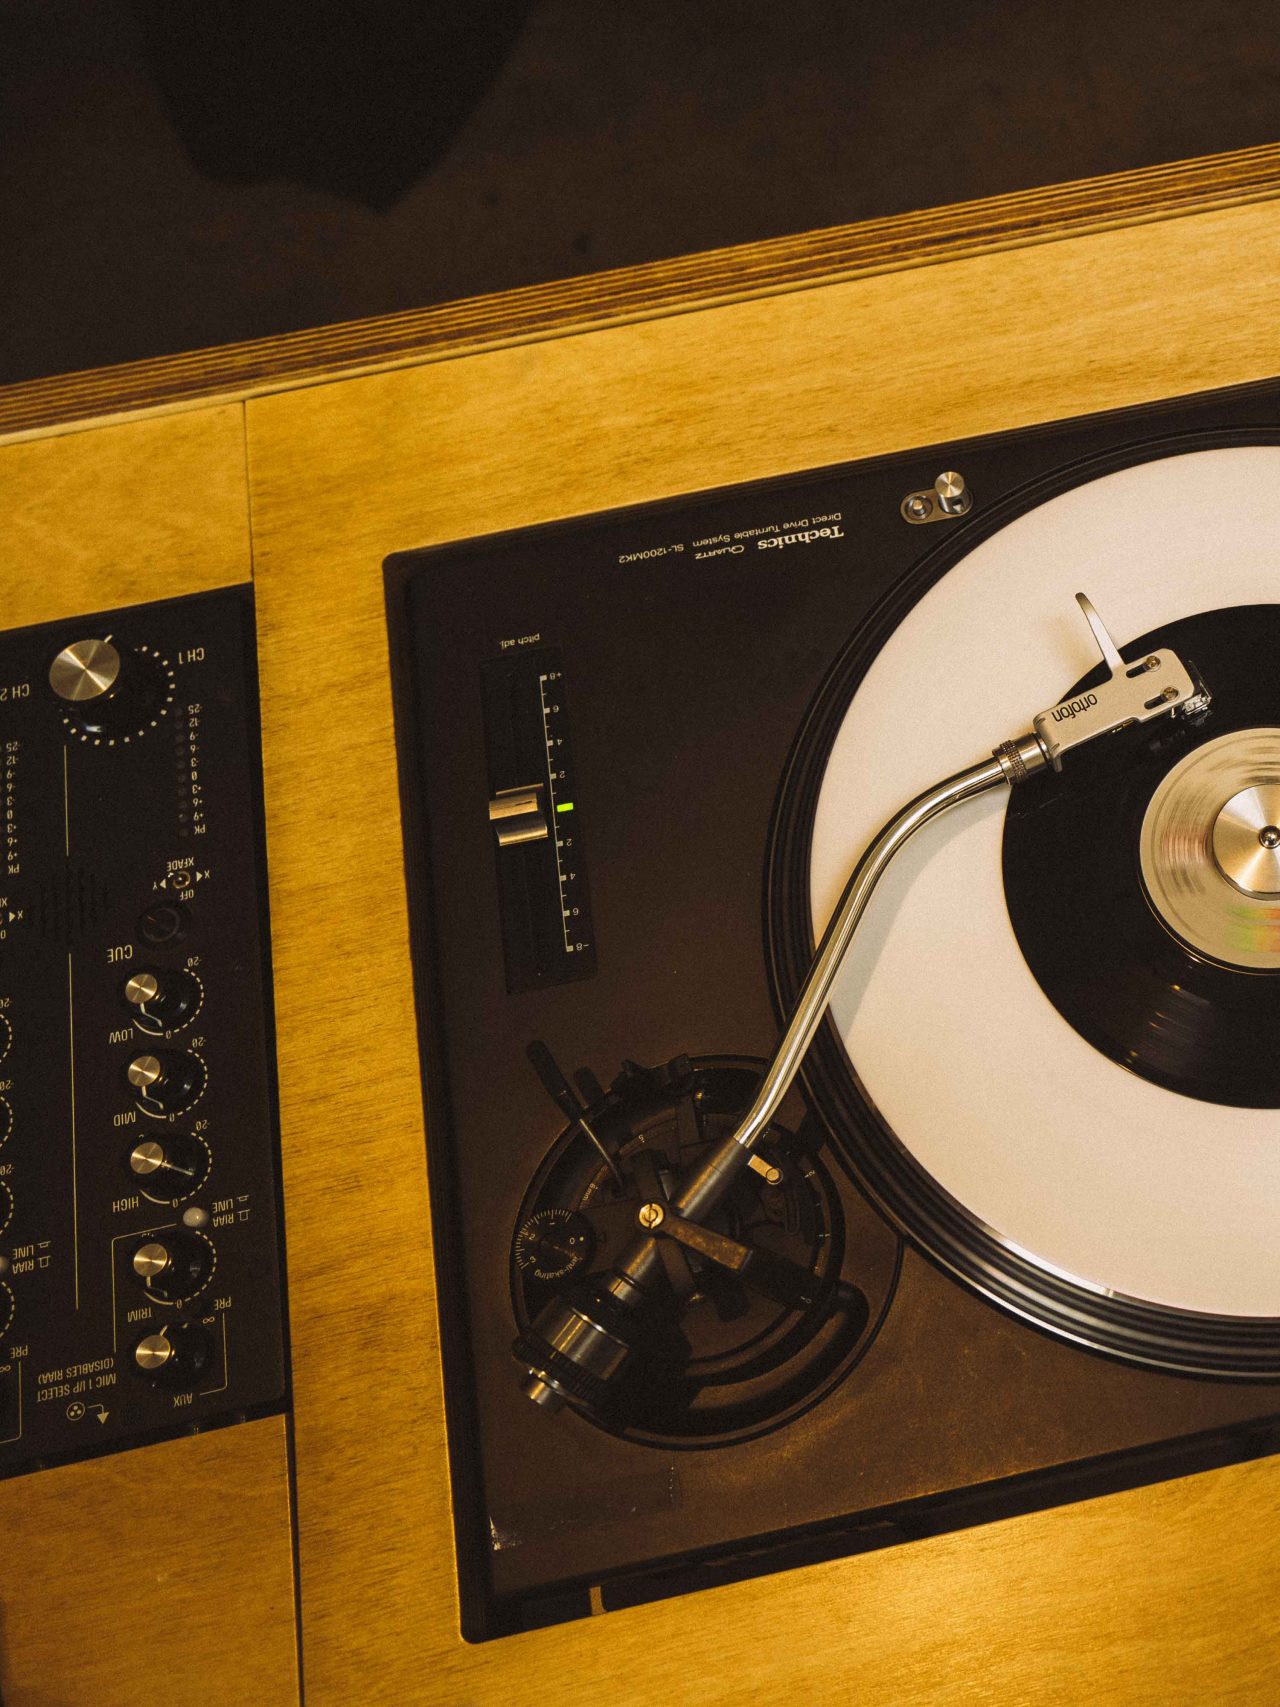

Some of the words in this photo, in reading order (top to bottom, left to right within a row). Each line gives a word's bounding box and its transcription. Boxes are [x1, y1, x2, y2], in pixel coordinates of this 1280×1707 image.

[783, 519, 808, 529] Drive
[812, 513, 841, 524] Direct
[734, 524, 780, 539] Turntable
[757, 525, 844, 550] Technics
[692, 534, 730, 547] System
[618, 543, 684, 563] SL-1200MK2
[499, 638, 515, 650] adj.
[518, 633, 540, 646] pitch
[178, 652, 184, 664] 1
[187, 647, 205, 662] CH
[0, 687, 7, 701] 2
[12, 683, 30, 700] CH
[1051, 694, 1097, 722] ortofon
[192, 771, 197, 781] 0
[560, 770, 565, 778] 2
[192, 784, 201, 794] +3
[193, 798, 203, 807] +6
[193, 812, 203, 821] +9
[194, 824, 206, 835] PK
[7, 837, 18, 847] +6
[566, 838, 572, 846] 2
[8, 851, 18, 861] +9
[8, 864, 20, 874] PK
[166, 857, 194, 872] XFADE
[204, 870, 210, 879] X
[152, 881, 158, 891] Y
[179, 889, 194, 901] OFF
[18, 910, 24, 920] X
[576, 943, 590, 951] -8
[106, 944, 133, 964] CUE
[109, 1028, 134, 1044] LOW
[165, 1030, 171, 1039] 0
[113, 1111, 136, 1127] MID
[169, 1113, 175, 1122] 0
[112, 1196, 139, 1213] HIGH
[172, 1198, 178, 1208] 0
[212, 1199, 234, 1213] LINE
[212, 1213, 234, 1227] RIAA
[570, 1237, 575, 1245] 0
[12, 1244, 34, 1260] LINE
[12, 1259, 34, 1275] RIAA
[214, 1296, 232, 1310] PRE
[128, 1307, 152, 1323] TRIM
[10, 1344, 28, 1358] PRE
[66, 1357, 114, 1378] (DISABLES
[38, 1369, 63, 1384] RIAA)
[96, 1373, 116, 1388] MIC
[89, 1378, 92, 1390] 1
[36, 1384, 70, 1403] SELECT
[173, 1392, 192, 1408] AUX
